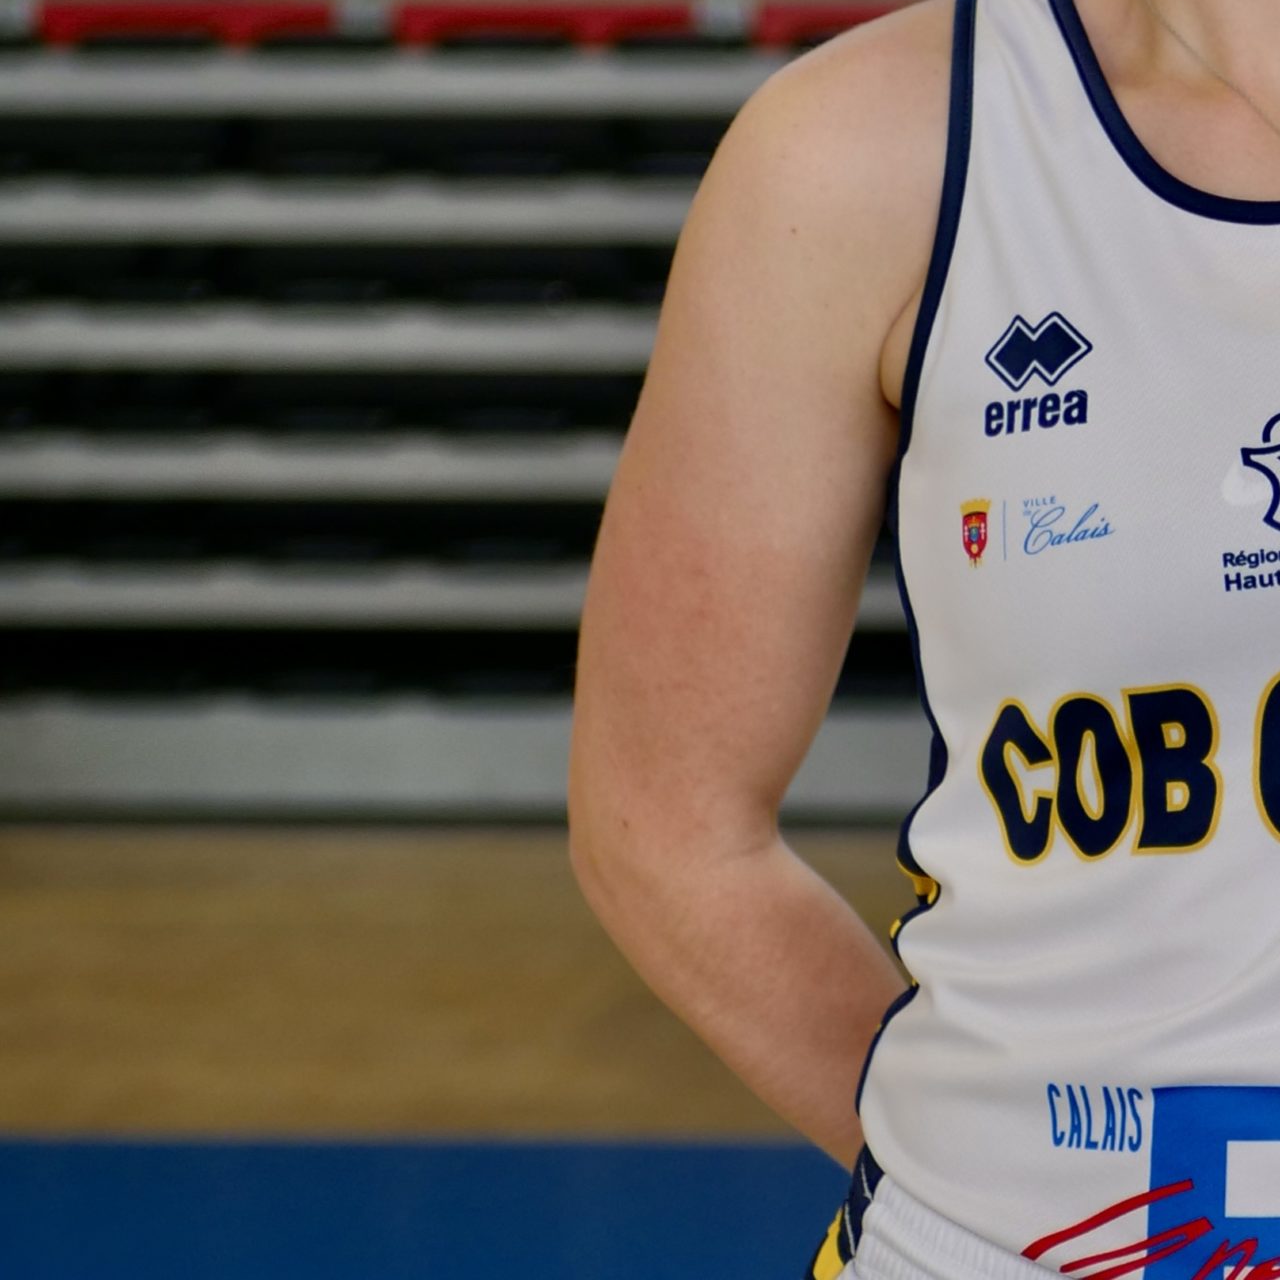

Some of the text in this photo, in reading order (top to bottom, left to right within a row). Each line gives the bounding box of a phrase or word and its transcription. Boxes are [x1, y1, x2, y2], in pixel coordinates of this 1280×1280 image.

[984, 389, 1088, 437] errea
[1023, 496, 1056, 508] VILLE
[1024, 503, 1116, 555] Calais
[978, 683, 1223, 868] COB
[1046, 1082, 1146, 1153] CALAIS
